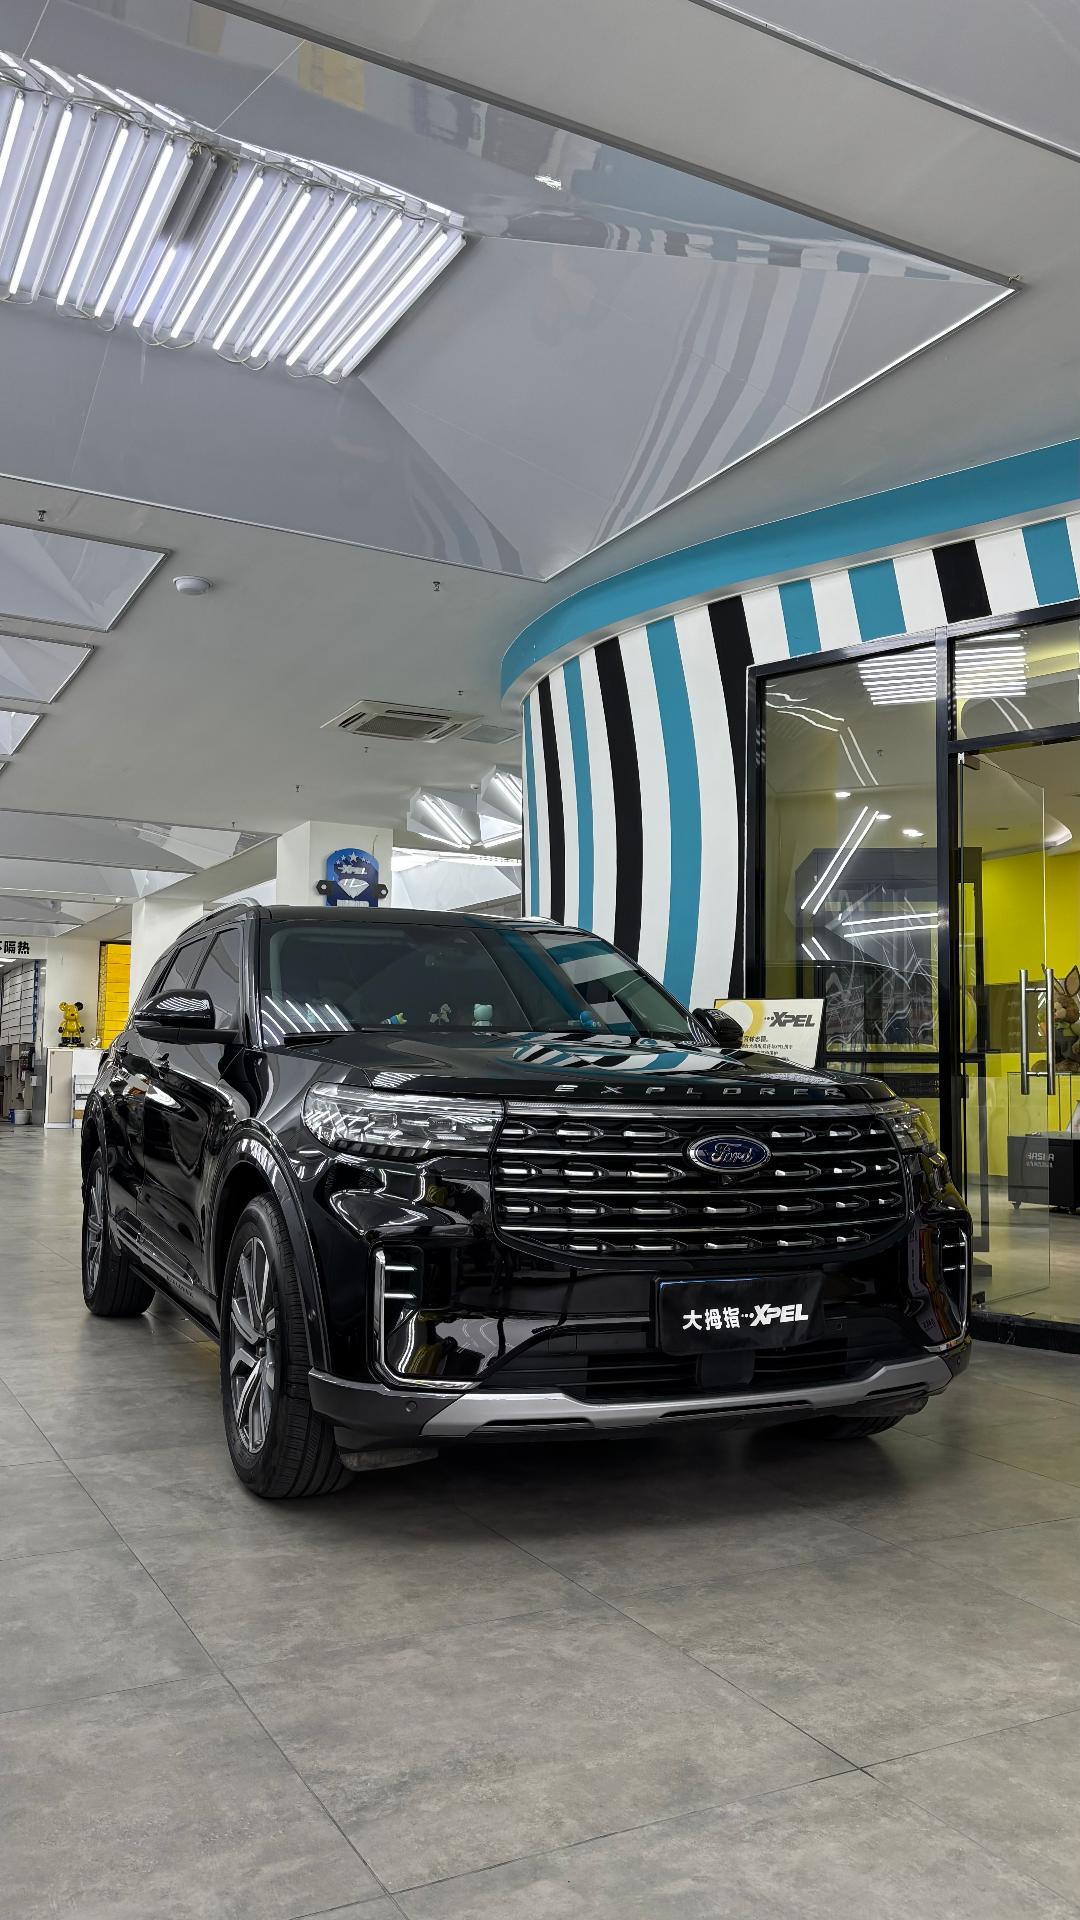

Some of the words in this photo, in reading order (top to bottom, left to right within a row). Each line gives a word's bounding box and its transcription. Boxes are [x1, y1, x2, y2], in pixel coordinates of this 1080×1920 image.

[0, 940, 30, 954] 隔热
[768, 1011, 816, 1027] XPEL
[554, 1084, 846, 1098] EXPLORER
[711, 1142, 752, 1163] Ford
[682, 1306, 741, 1331] 大拇指
[750, 1303, 809, 1327] XPEL
